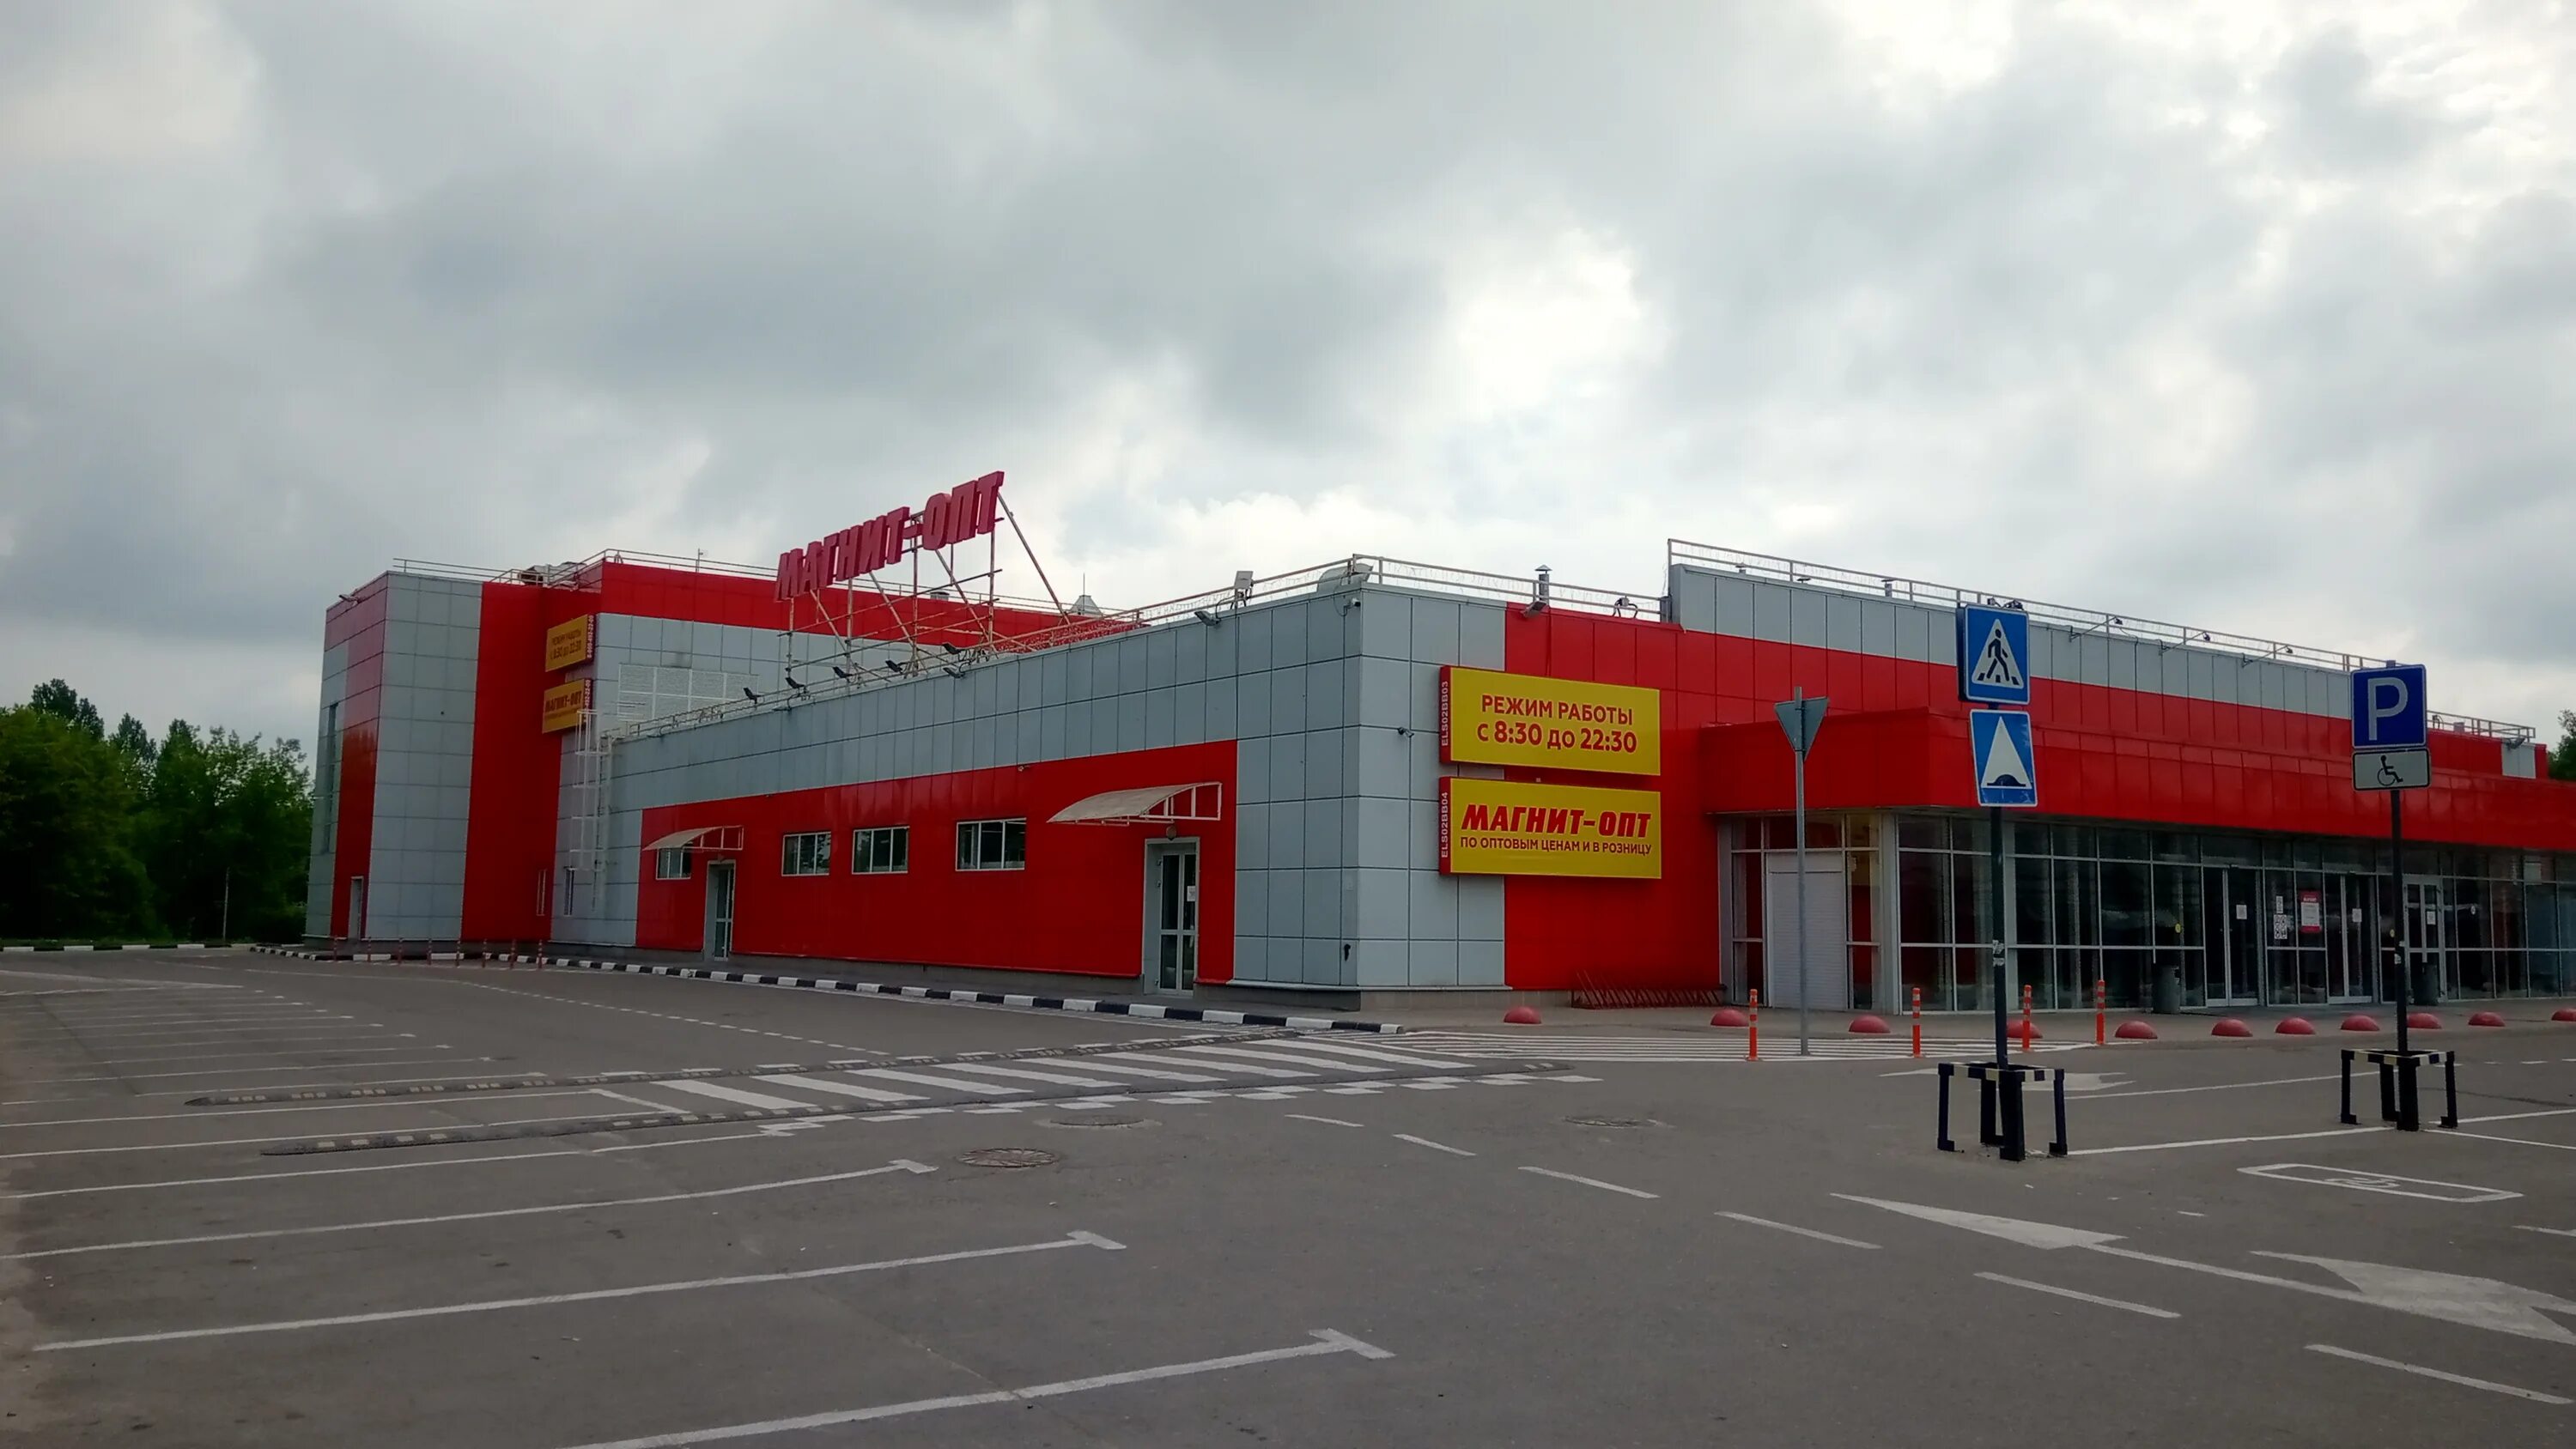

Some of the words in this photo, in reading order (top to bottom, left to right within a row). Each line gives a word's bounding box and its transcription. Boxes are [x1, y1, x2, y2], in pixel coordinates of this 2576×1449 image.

[775, 470, 1005, 601] МАГНИТ-ОПТ
[1481, 694, 1552, 718] РЕЖИМ
[1558, 702, 1632, 725] РАБОТЫ
[2367, 676, 2409, 741] P
[1494, 720, 1542, 746] 8:30
[1580, 728, 1637, 754] 22:30
[1461, 803, 1651, 839] МАГНИТ-ОПТ
[1461, 836, 1477, 848] ПО
[1480, 838, 1539, 851] ОПТОВЫМ
[1541, 840, 1580, 852] ЦЕНАМ
[1583, 842, 1589, 852] И
[1593, 842, 1600, 852] В
[1602, 843, 1651, 856] РОЗНИЦУ
